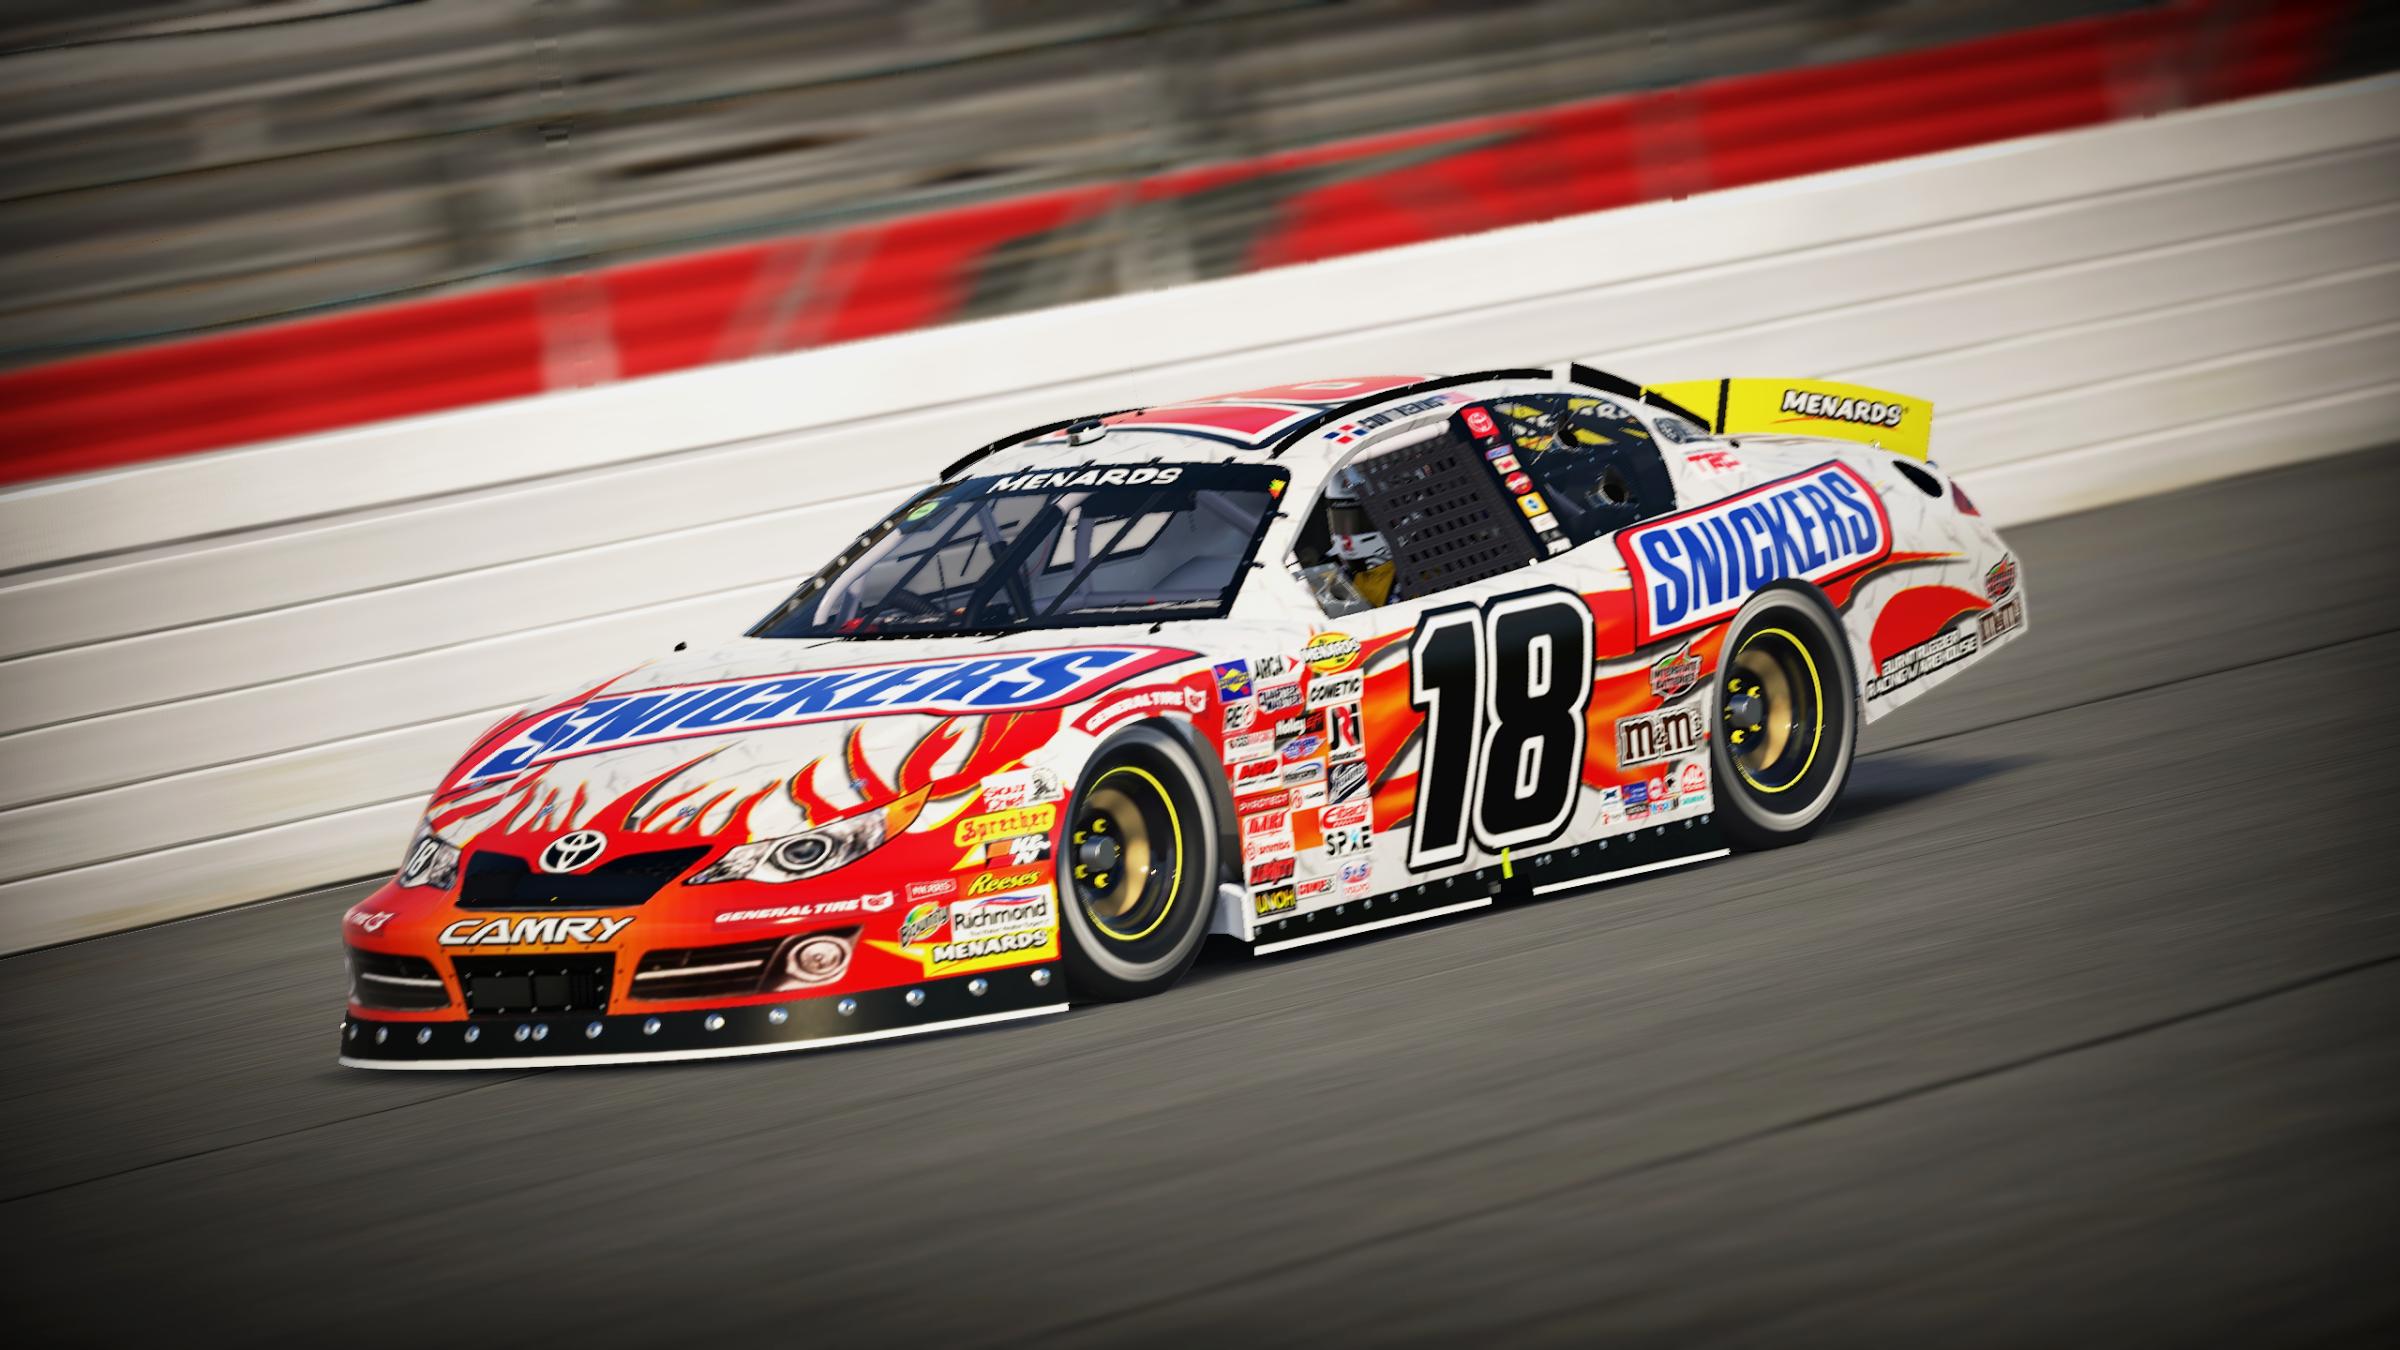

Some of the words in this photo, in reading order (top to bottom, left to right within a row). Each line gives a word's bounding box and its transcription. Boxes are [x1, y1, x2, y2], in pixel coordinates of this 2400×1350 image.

[1778, 387, 1904, 428] MENARDS
[985, 466, 1183, 496] MENARDS
[1637, 469, 1880, 628] SNICKERS
[1310, 677, 1360, 702] COMETIC
[470, 648, 1135, 780] SNICKERS
[1408, 586, 1595, 874] 18
[959, 809, 1051, 844] Sprecher
[437, 915, 636, 946] CAMRY
[954, 895, 1048, 931] Richmond
[932, 929, 1049, 964] MENARDS
